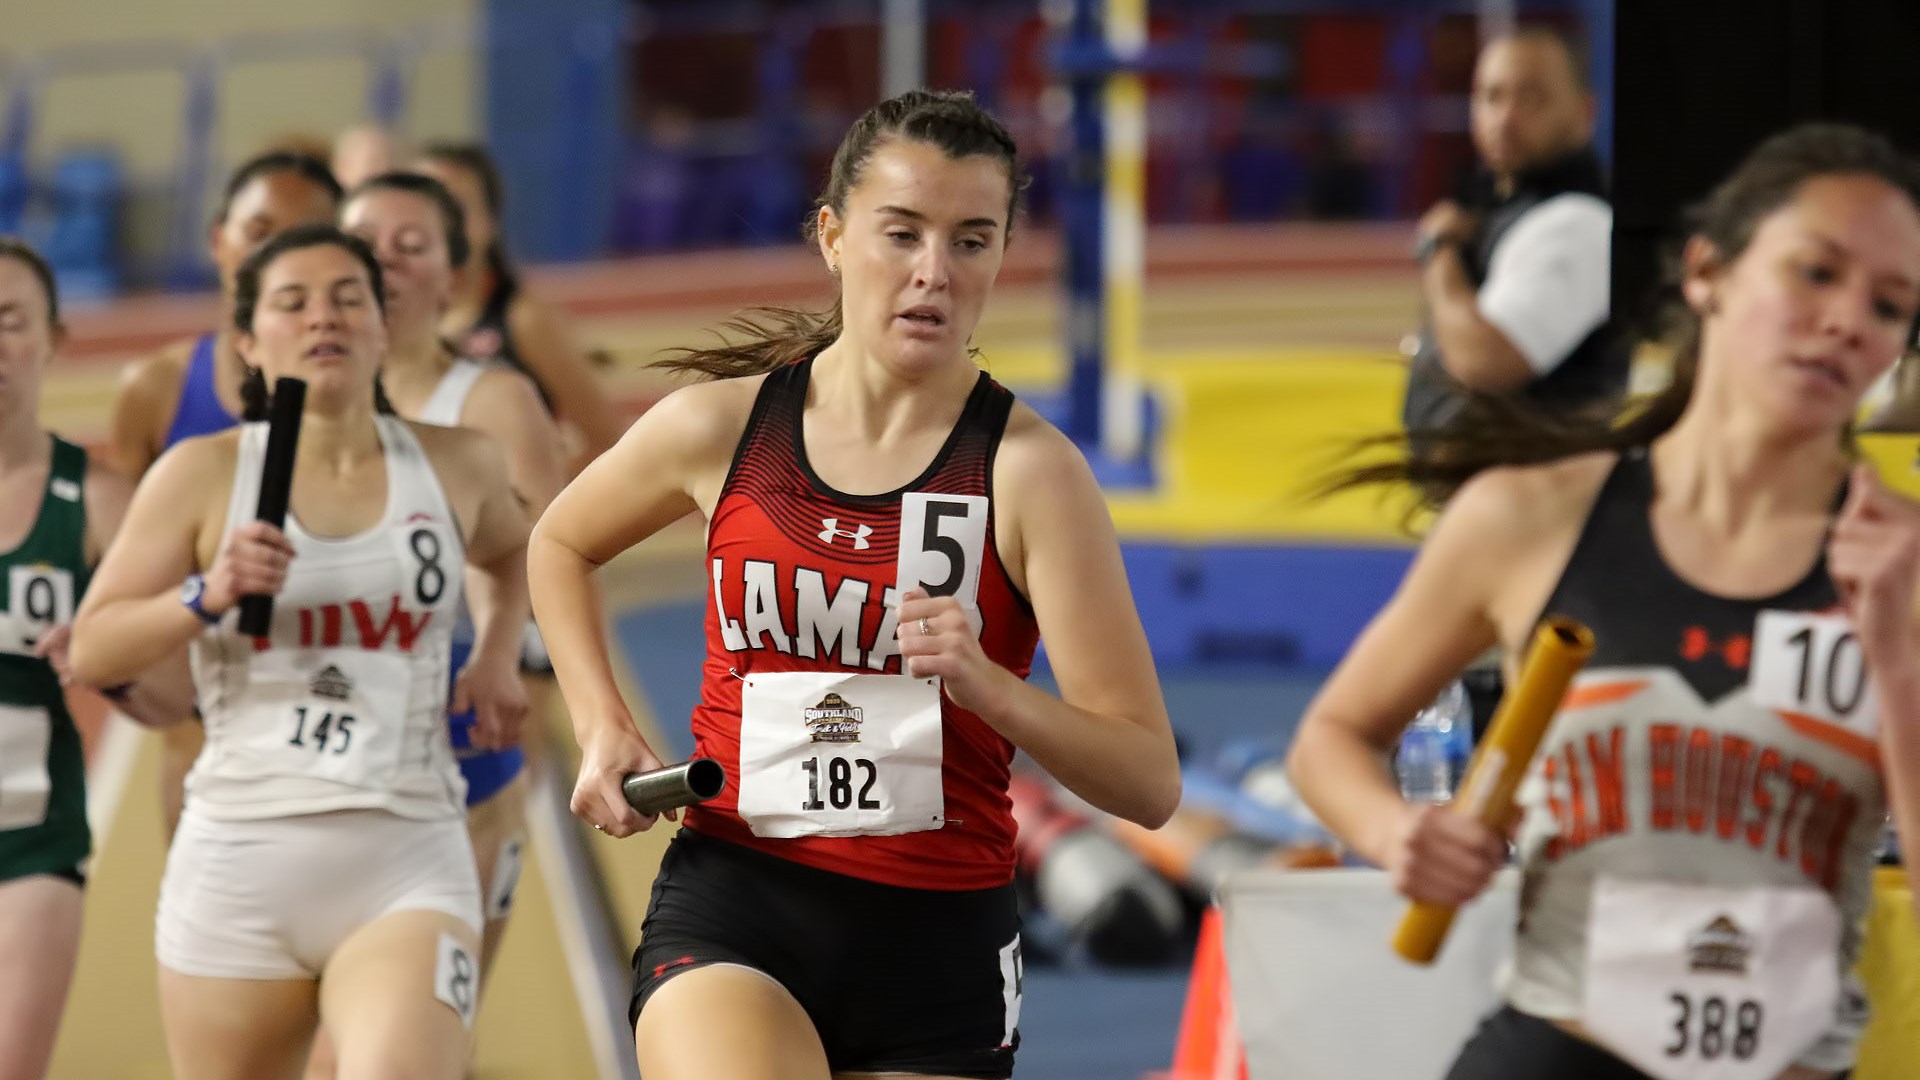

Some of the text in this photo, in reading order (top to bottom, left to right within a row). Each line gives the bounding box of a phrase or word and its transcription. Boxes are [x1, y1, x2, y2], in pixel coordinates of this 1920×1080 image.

[409, 528, 446, 605] 8
[918, 499, 969, 597] 5
[25, 576, 56, 647] 9
[712, 557, 984, 673] LAMA
[1787, 627, 1867, 716] 10
[289, 707, 356, 755] 145
[805, 707, 863, 725] SOUTHLAND
[802, 756, 881, 811] 182
[450, 948, 473, 1015] 8
[1665, 992, 1763, 1061] 388
